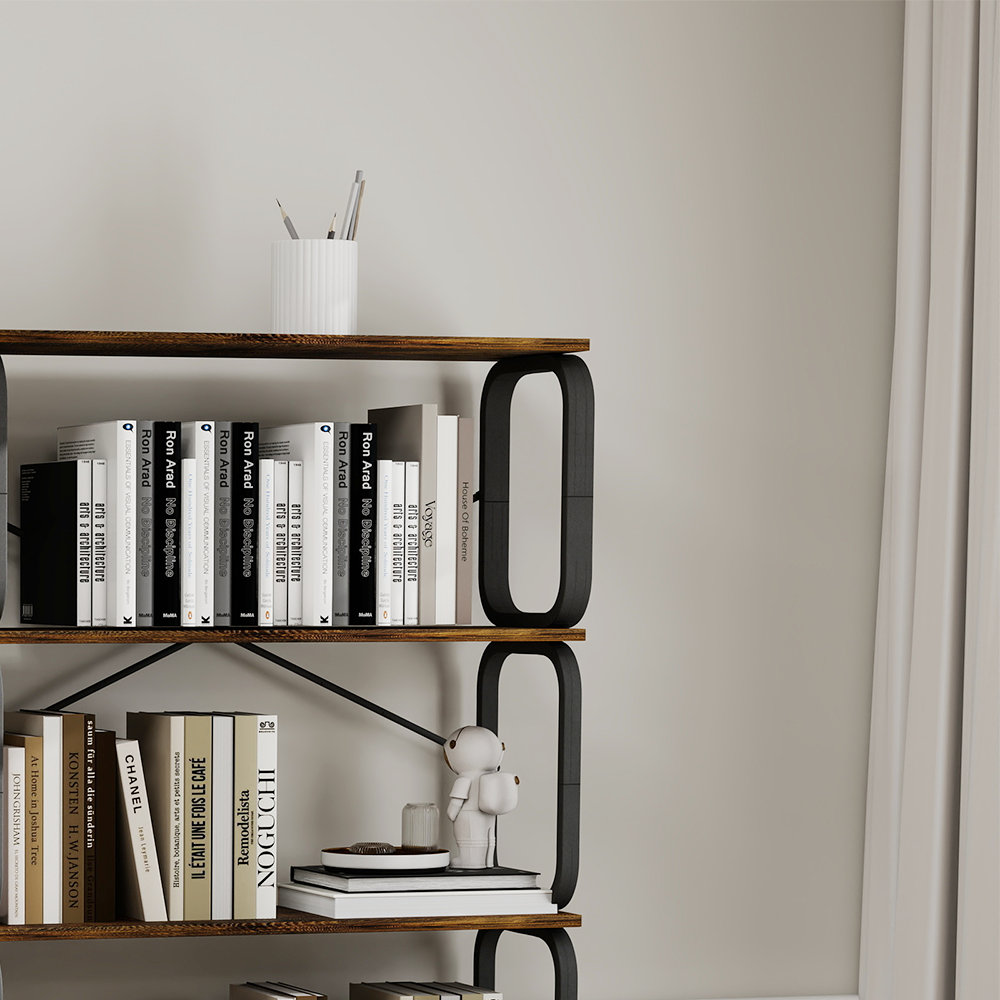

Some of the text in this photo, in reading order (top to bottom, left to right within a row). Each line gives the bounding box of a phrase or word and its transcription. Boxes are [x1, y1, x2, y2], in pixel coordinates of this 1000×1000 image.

[141, 429, 151, 454] Ron
[141, 459, 151, 487] Arad
[80, 502, 90, 518] arts
[163, 430, 176, 577] Ron Arad No Discipline
[359, 432, 373, 577] Ron Arad No Discipline
[408, 505, 418, 520] arts
[462, 512, 469, 524] Of
[422, 500, 436, 548] Voyage
[80, 532, 91, 583] architecture
[408, 534, 419, 581] architecture
[31, 756, 39, 766] At
[87, 766, 95, 785] alla
[69, 752, 79, 815] KONSTEN
[87, 787, 95, 802] die
[125, 754, 142, 814] CHANEL
[31, 800, 37, 808] in
[188, 757, 206, 879] IL ÉTAIT UNE FOIS LE CAFÉ
[29, 811, 40, 842] Joshua
[237, 790, 249, 866] Remodelista
[258, 770, 275, 888] NOGUCHI
